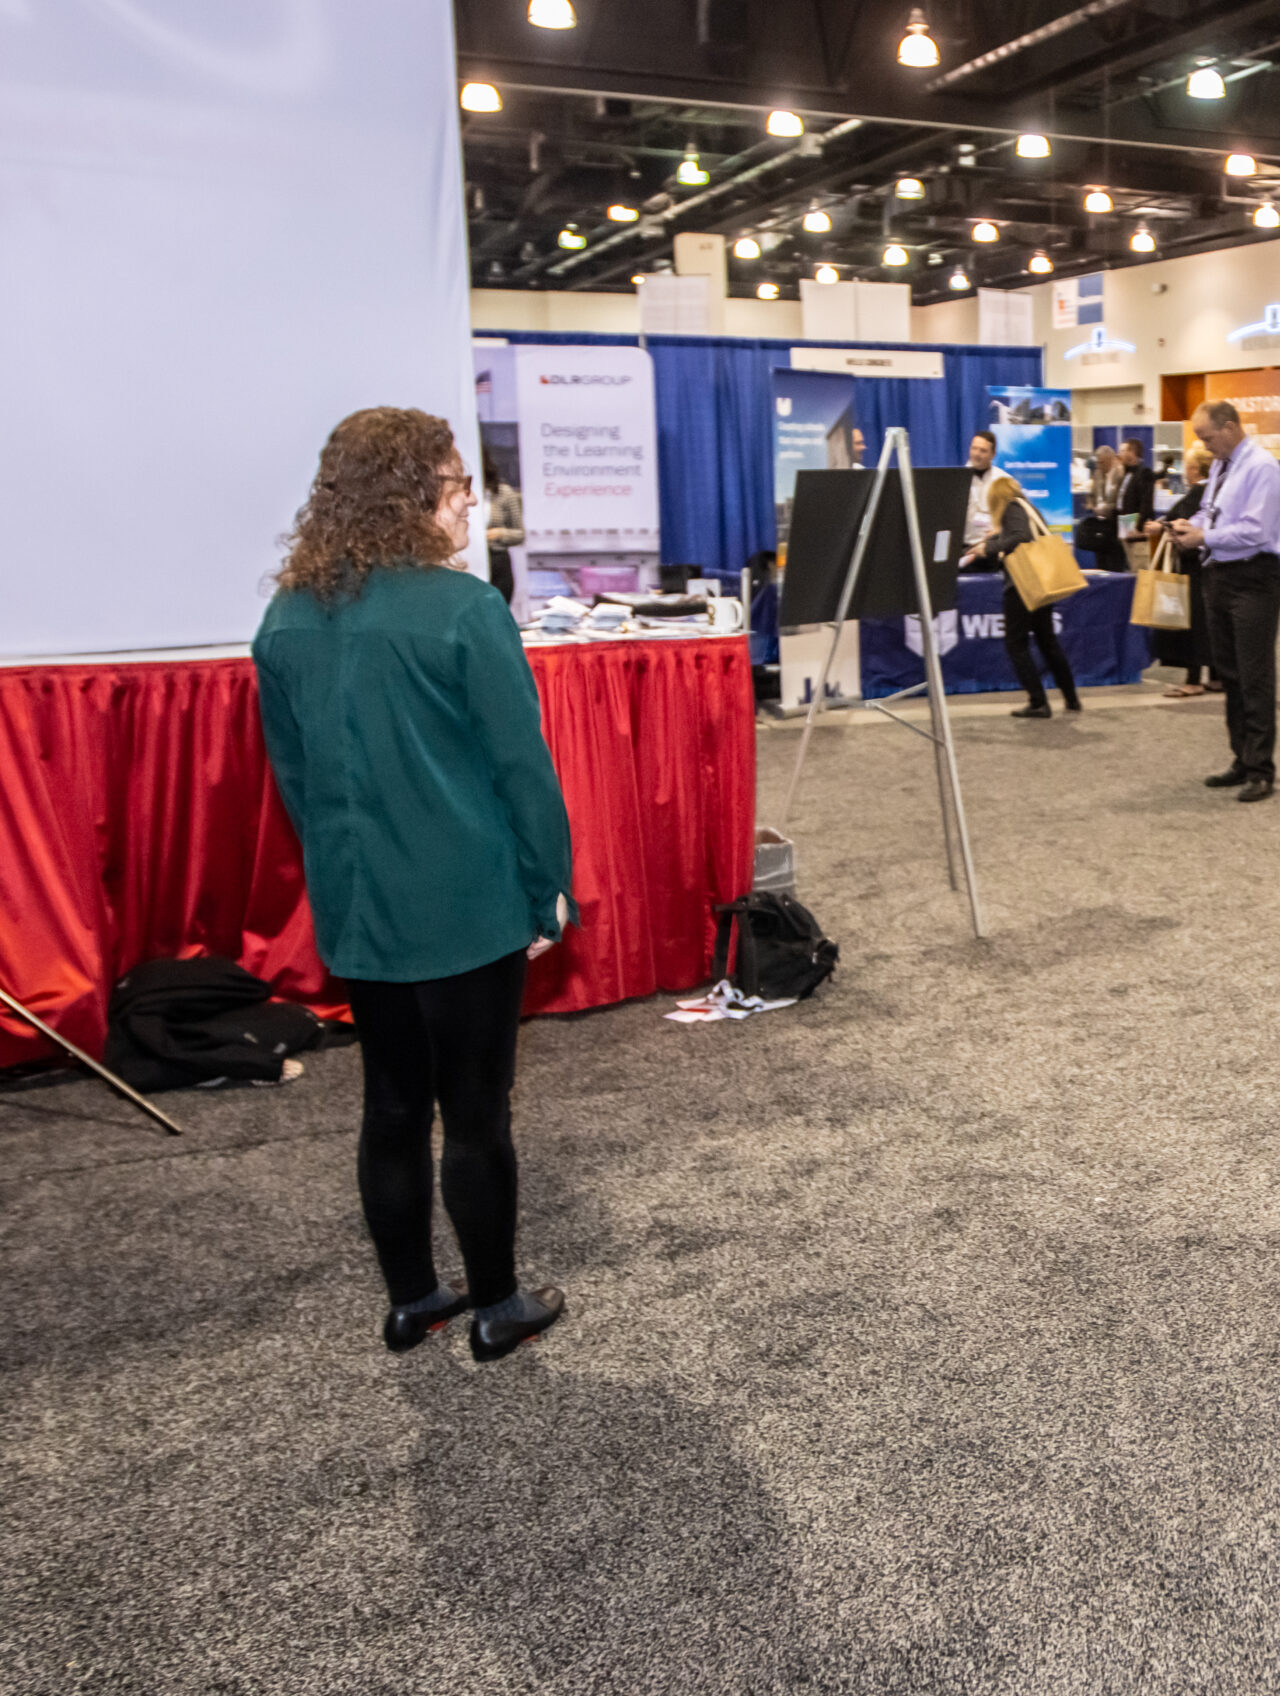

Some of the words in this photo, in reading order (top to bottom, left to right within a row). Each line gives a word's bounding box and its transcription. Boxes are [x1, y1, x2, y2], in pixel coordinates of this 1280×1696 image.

[541, 423, 620, 440] Designing
[543, 444, 570, 457] the
[574, 444, 643, 460] Learning
[543, 462, 641, 476] Environment
[545, 482, 632, 498] Experience
